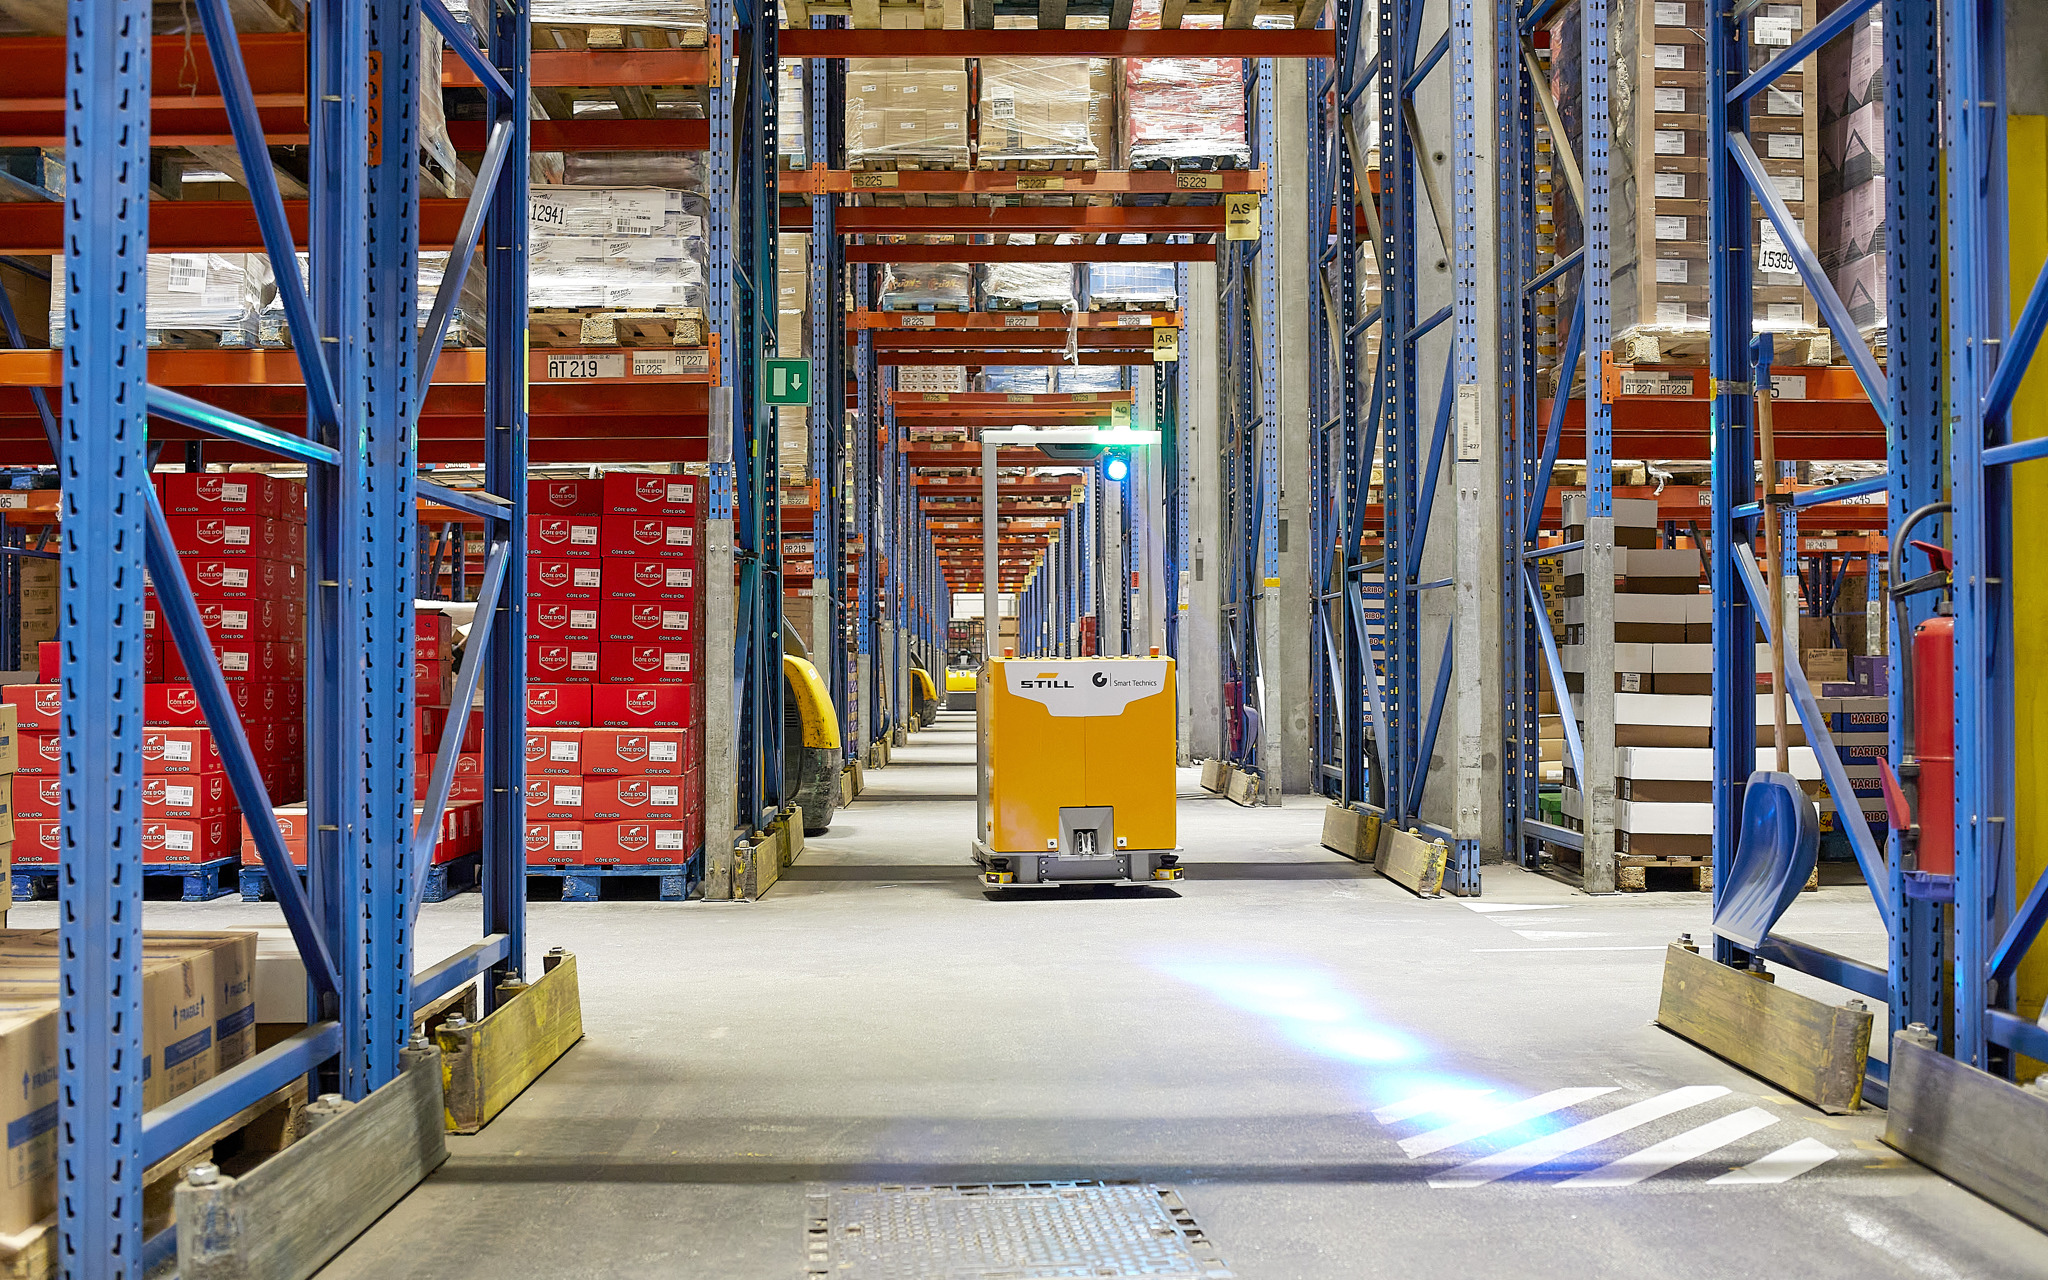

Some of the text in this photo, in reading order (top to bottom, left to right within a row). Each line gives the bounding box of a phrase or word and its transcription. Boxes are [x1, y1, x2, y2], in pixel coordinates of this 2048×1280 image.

[531, 204, 564, 224] 12941
[1231, 203, 1250, 215] AS
[1762, 250, 1793, 270] 15399
[1020, 680, 1074, 688] STILL
[1114, 679, 1131, 687] Smart
[1851, 714, 1887, 724] HARIBO
[1850, 747, 1887, 757] HARIBO
[1865, 812, 1887, 822] RIBO
